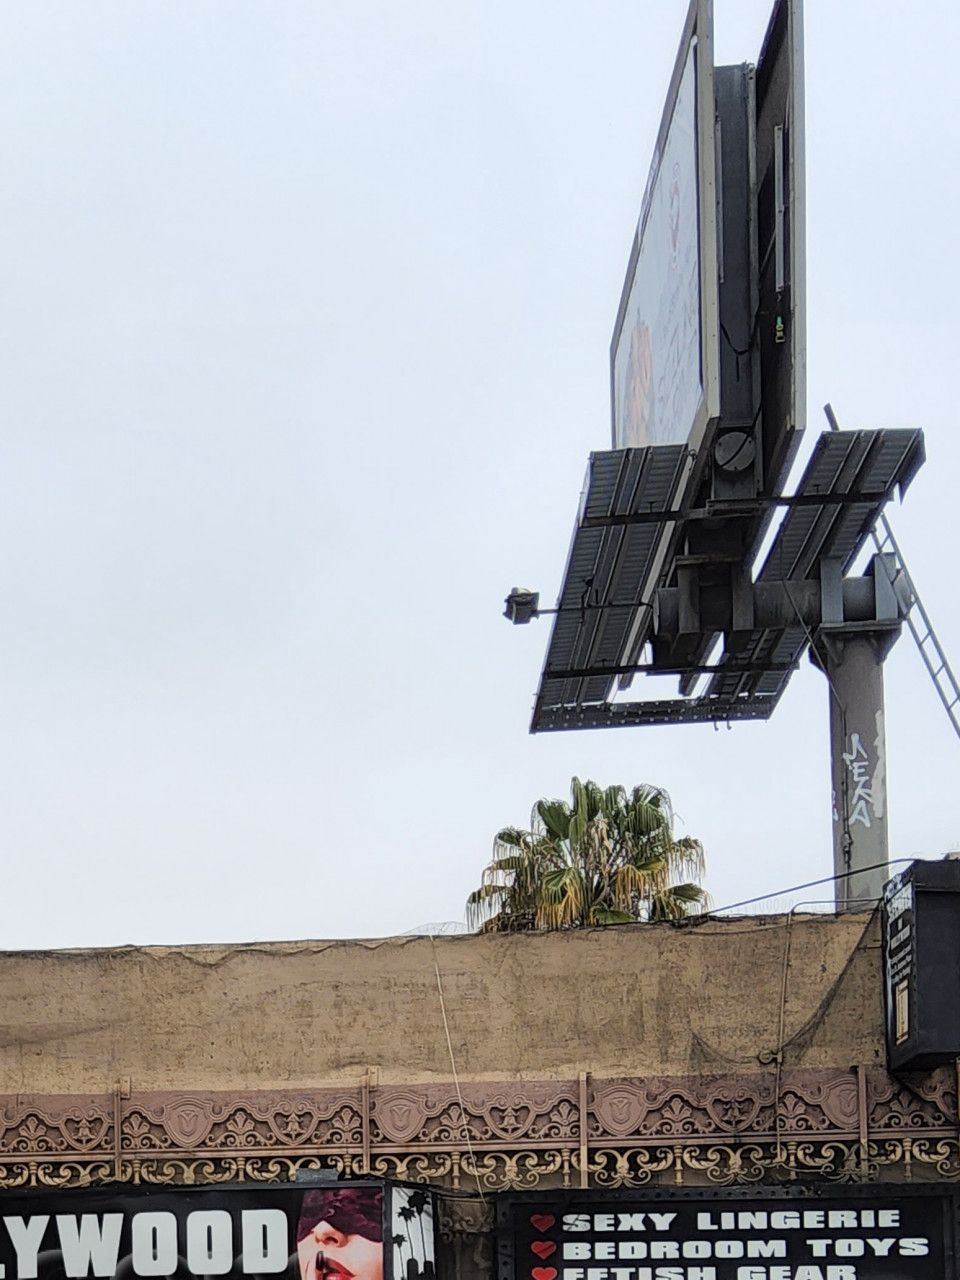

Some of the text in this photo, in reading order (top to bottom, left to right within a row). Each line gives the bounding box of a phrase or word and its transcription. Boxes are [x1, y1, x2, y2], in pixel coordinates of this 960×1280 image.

[562, 1210, 901, 1233] SEXY LINGERIE
[562, 1238, 930, 1261] BEDROOM TOYS
